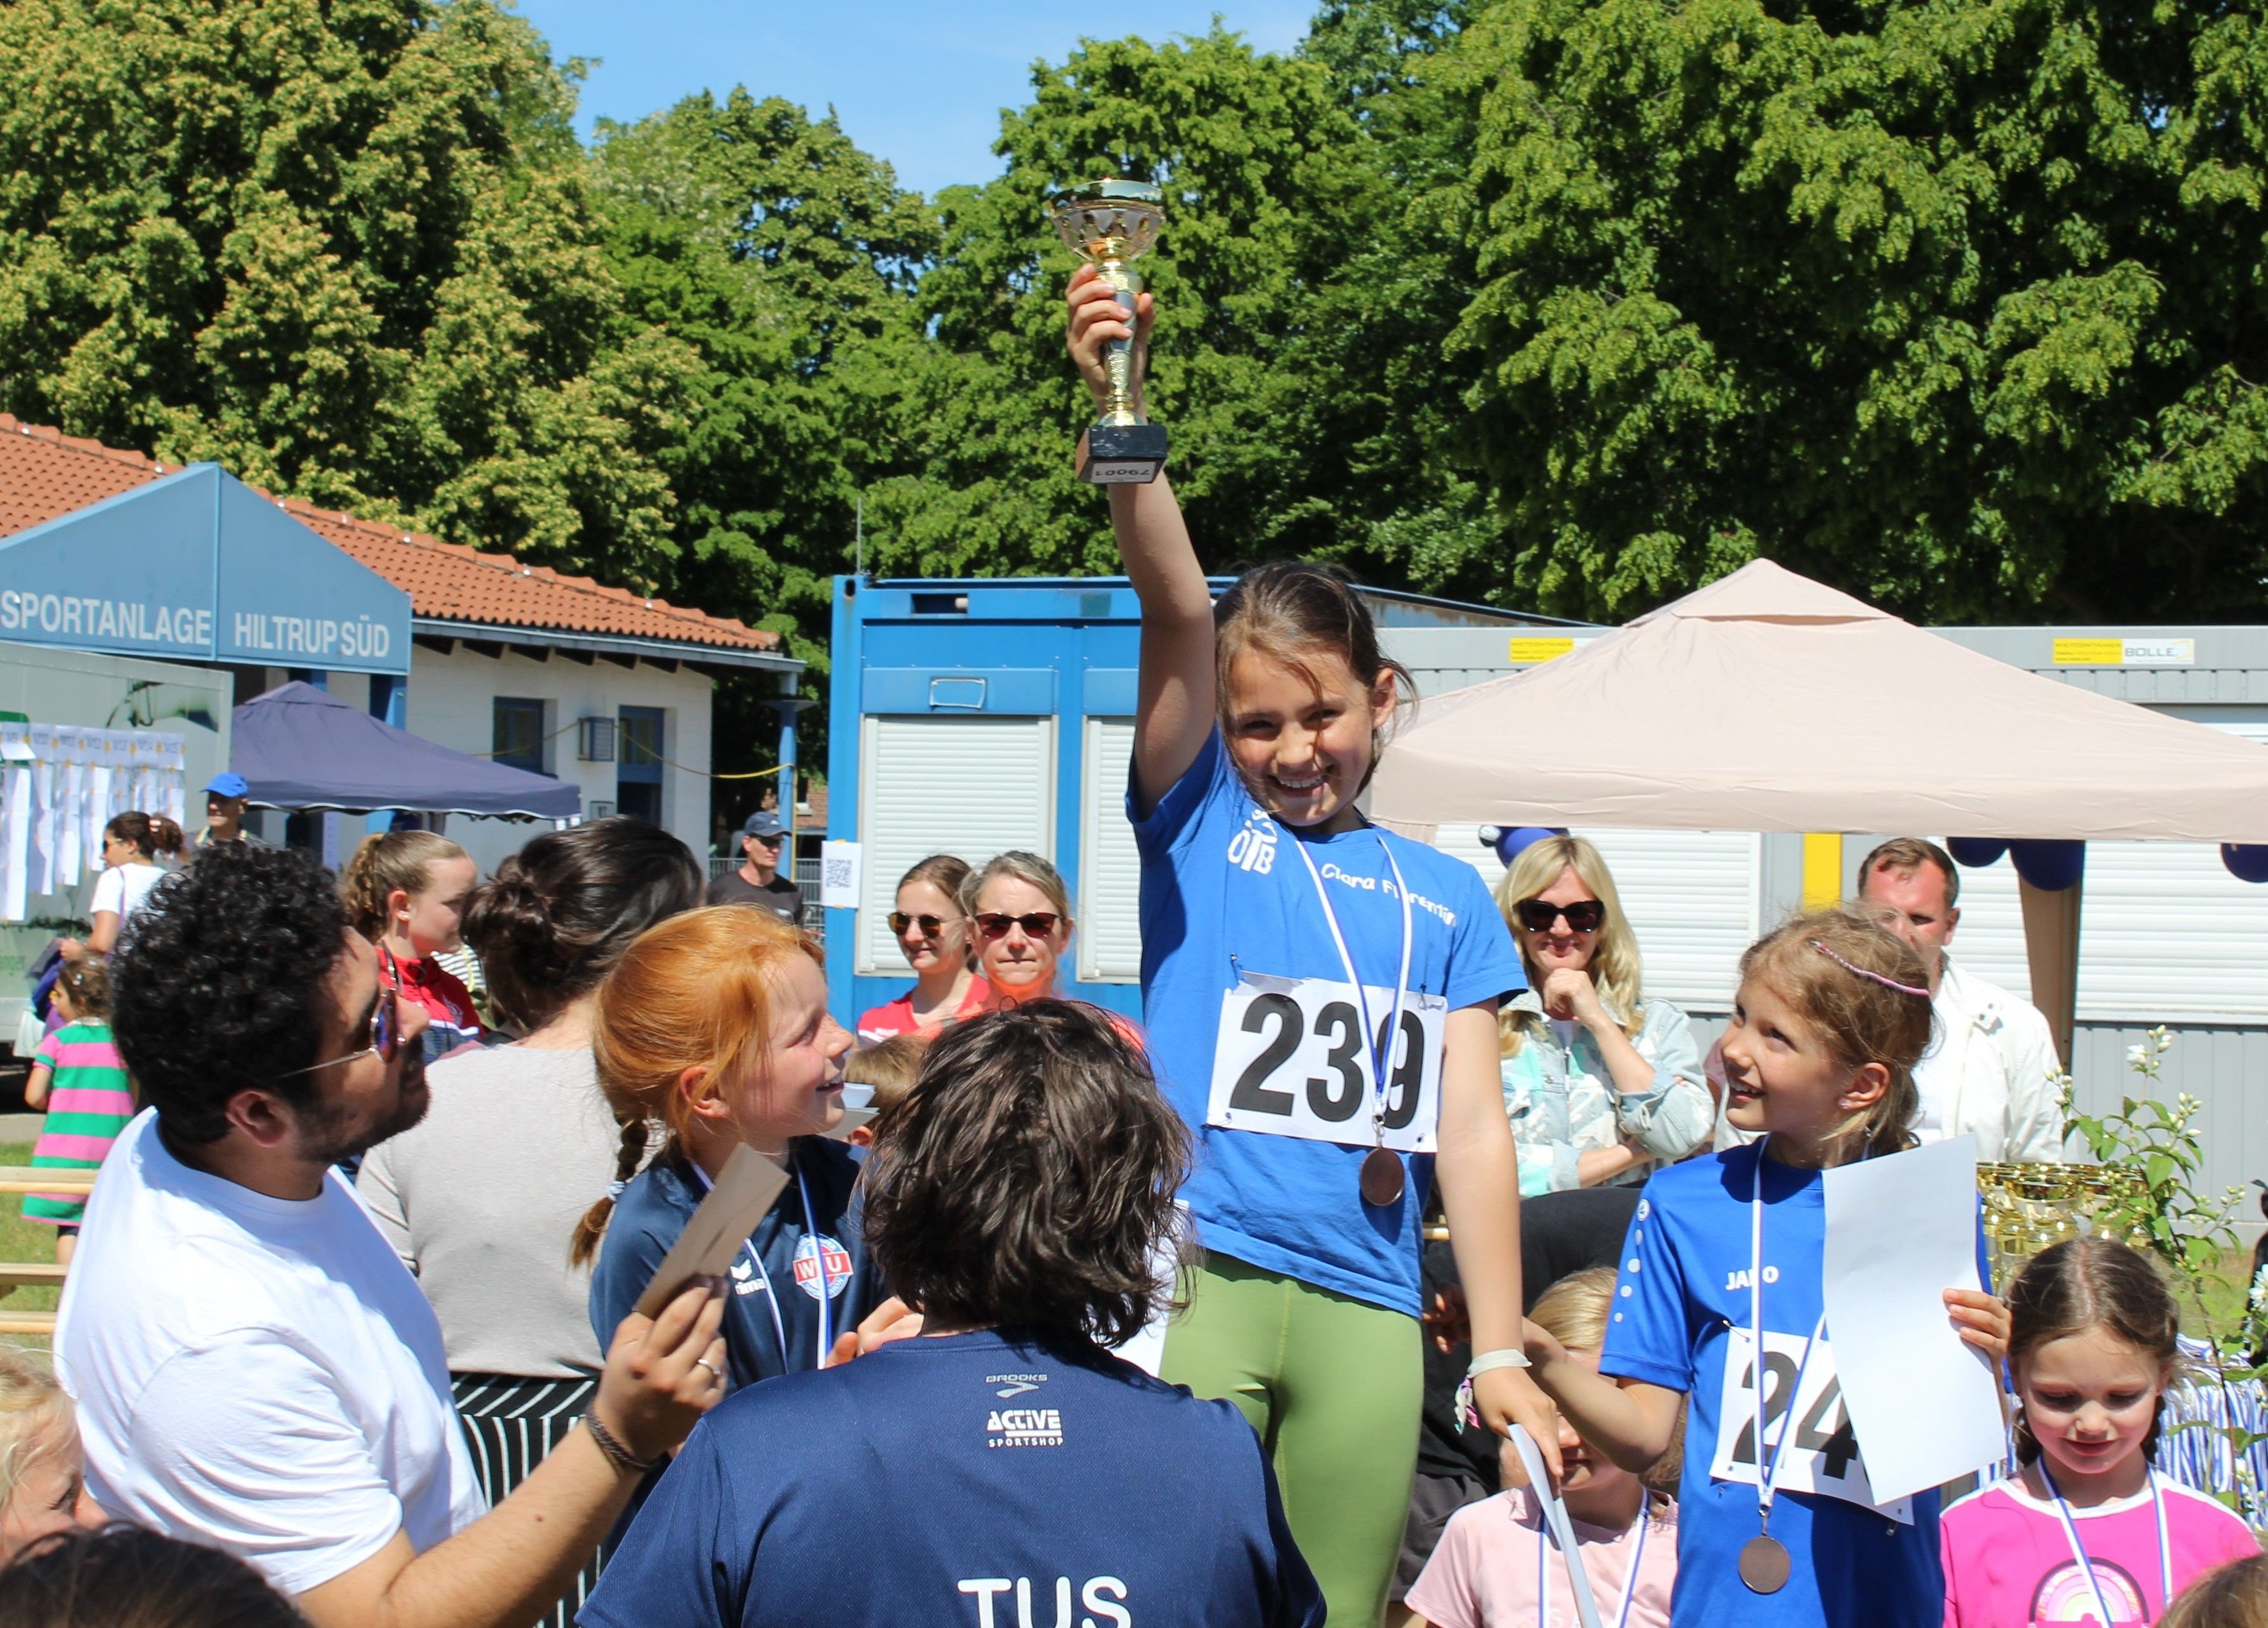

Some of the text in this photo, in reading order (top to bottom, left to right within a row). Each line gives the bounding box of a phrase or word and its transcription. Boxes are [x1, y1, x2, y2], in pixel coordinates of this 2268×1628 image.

[1, 590, 212, 646] SPORTANLAGE
[2125, 648, 2175, 657] BOLLE
[1321, 863, 1376, 890] Clara
[1229, 993, 1424, 1130] 239
[797, 1255, 843, 1279] WU
[1725, 1265, 1780, 1291] JAO
[986, 1374, 1048, 1383] BROOKS
[1732, 1351, 1872, 1480] 24
[989, 1437, 1064, 1447] SPORTSHOP
[957, 1576, 1133, 1628] TUS
